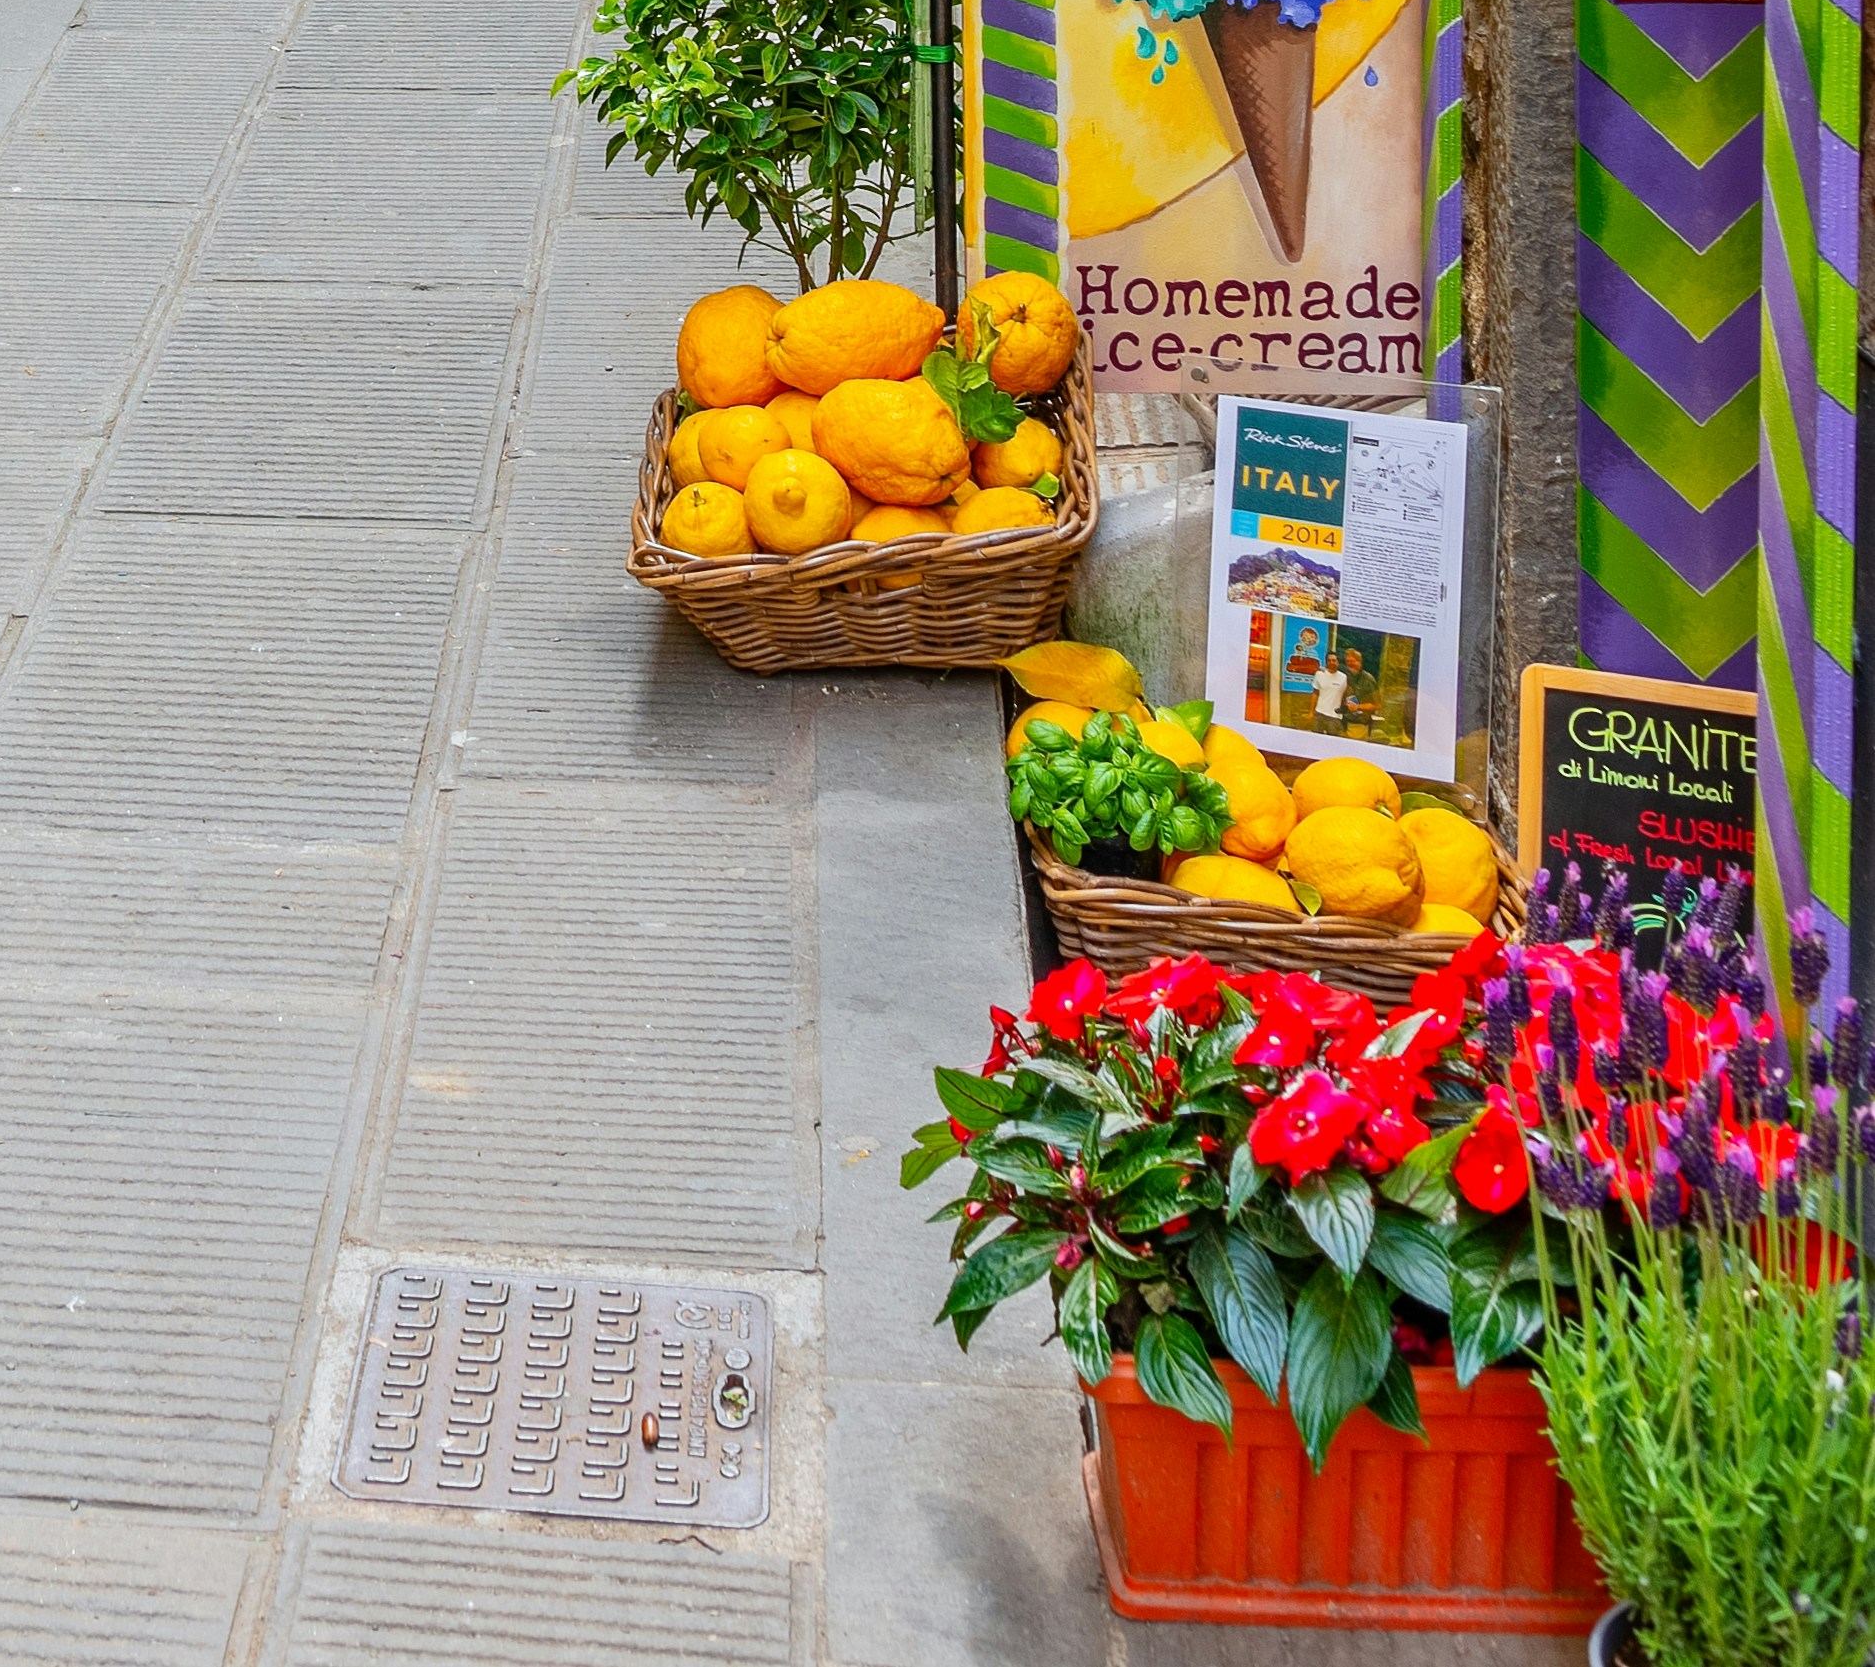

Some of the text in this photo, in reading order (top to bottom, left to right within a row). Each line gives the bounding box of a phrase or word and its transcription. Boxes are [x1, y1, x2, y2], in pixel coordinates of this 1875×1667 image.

[1075, 264, 1421, 321] Homemade
[1081, 318, 1423, 374] ice-cream
[1243, 427, 1287, 446] Rick
[1241, 465, 1341, 501] ITALY
[1281, 524, 1337, 548] 2014
[1558, 757, 1735, 804] di Limoni Locali
